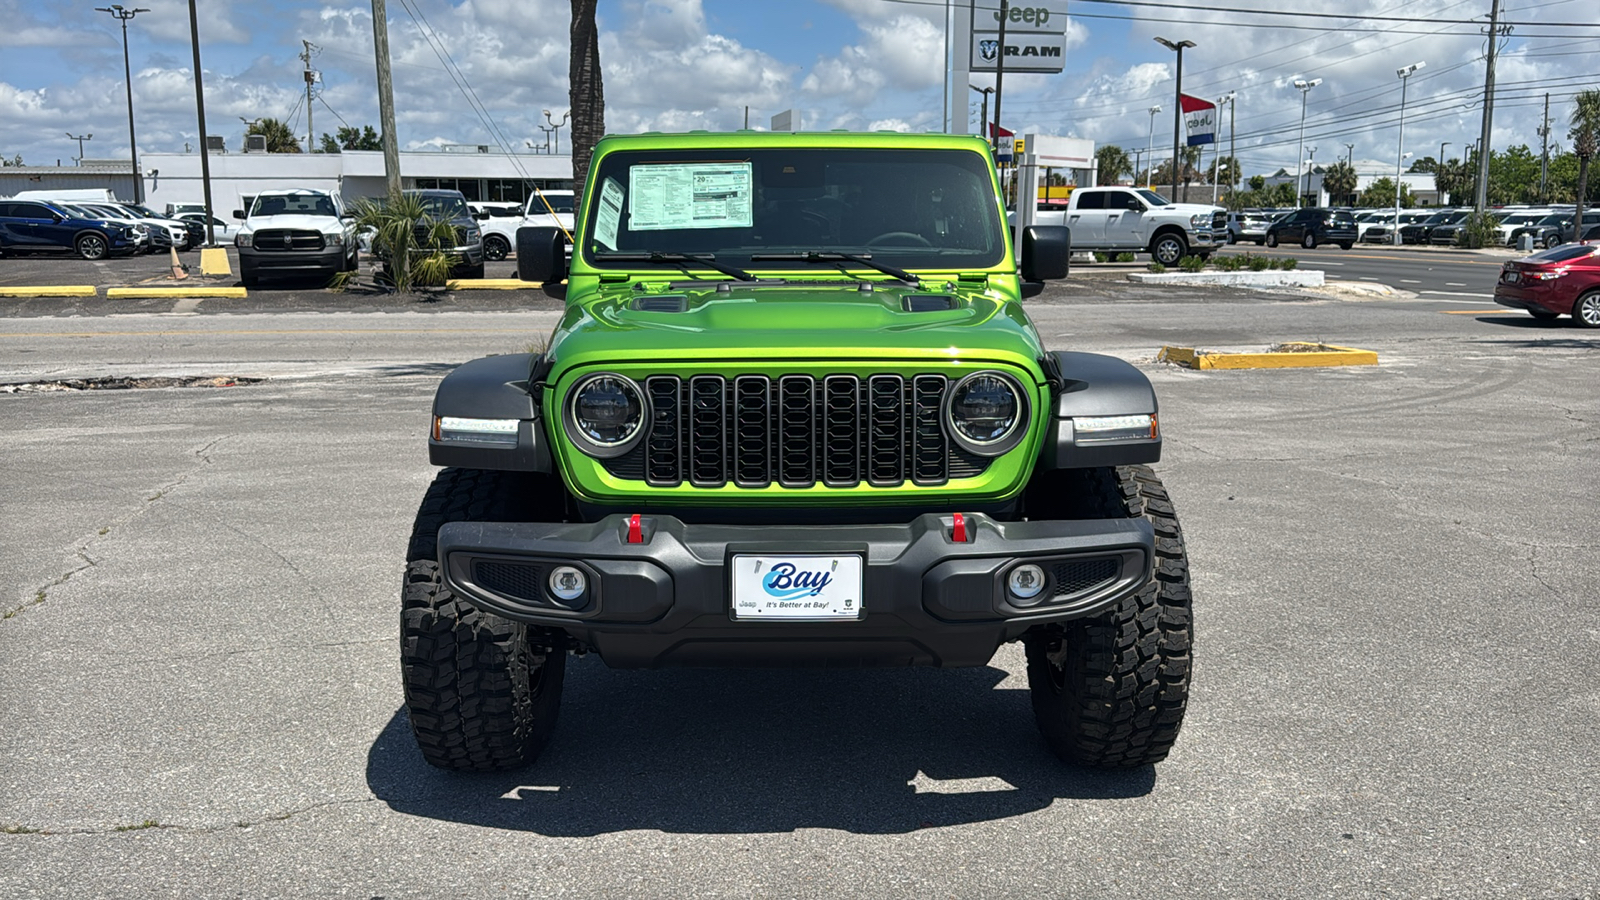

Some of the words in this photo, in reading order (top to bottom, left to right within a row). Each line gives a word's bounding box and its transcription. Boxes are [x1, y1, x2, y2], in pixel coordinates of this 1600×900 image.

[1004, 46, 1061, 57] RAM
[1015, 141, 1024, 151] F
[768, 562, 833, 597] Bay
[813, 601, 830, 610] Bay!
